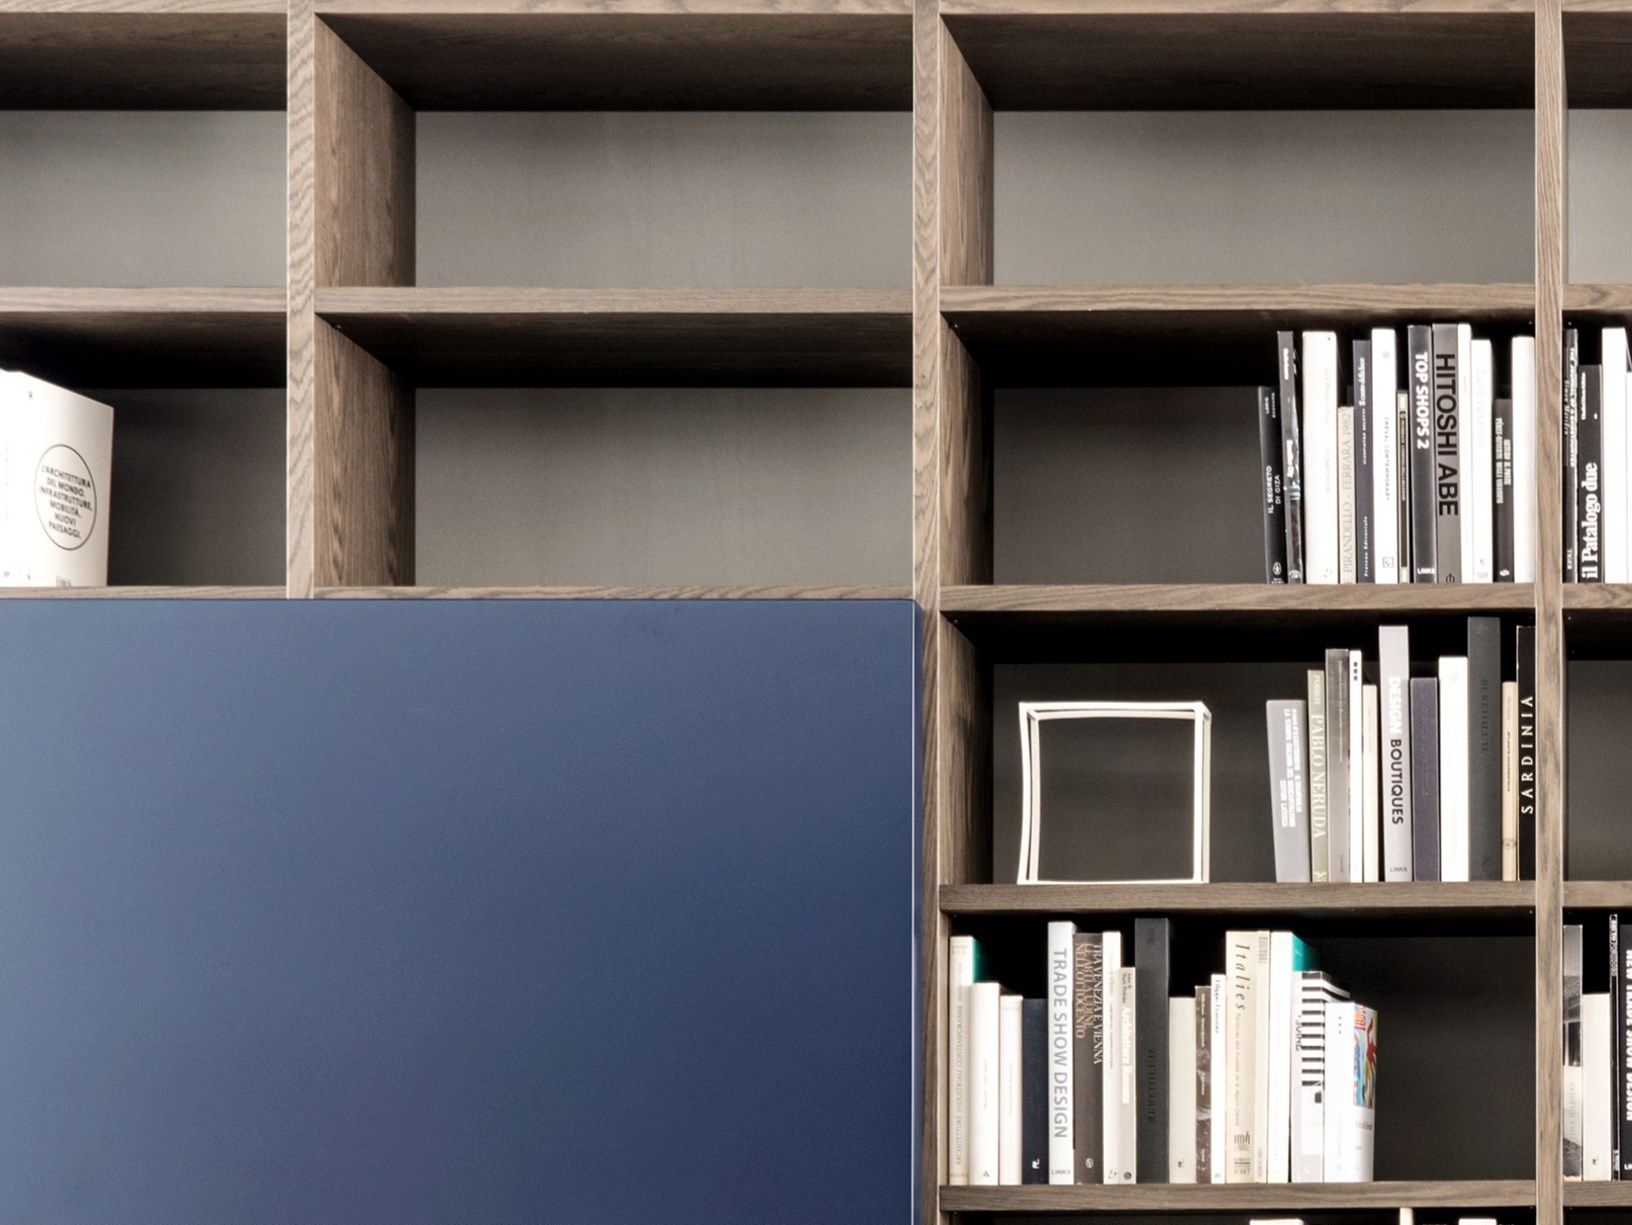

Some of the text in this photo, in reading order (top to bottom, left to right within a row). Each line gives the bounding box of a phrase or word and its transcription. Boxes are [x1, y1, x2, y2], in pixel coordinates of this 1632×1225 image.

[1415, 352, 1429, 449] TOP SHOPS 2
[1436, 354, 1457, 516] HITOSHI ABE
[1342, 413, 1353, 573] PIRANDELLO FERRARA 1982
[1581, 463, 1600, 578] il Patalogo due
[1311, 714, 1326, 838] PABLO NERUDA
[1389, 677, 1403, 825] DESIGN BOUTIQUES
[1521, 697, 1533, 815] SARDINIA
[1076, 943, 1085, 1038] NELL'OTTOCENTO
[1094, 944, 1102, 964] TRA
[1094, 966, 1102, 1012] VENEZIA
[1235, 944, 1250, 1011] Italies
[1054, 948, 1067, 1138] TRADE SHOW DESIGN
[1084, 994, 1094, 1029] UDINE
[1094, 1024, 1102, 1064] VIENNA
[1121, 1007, 1131, 1103] Architettura Romana
